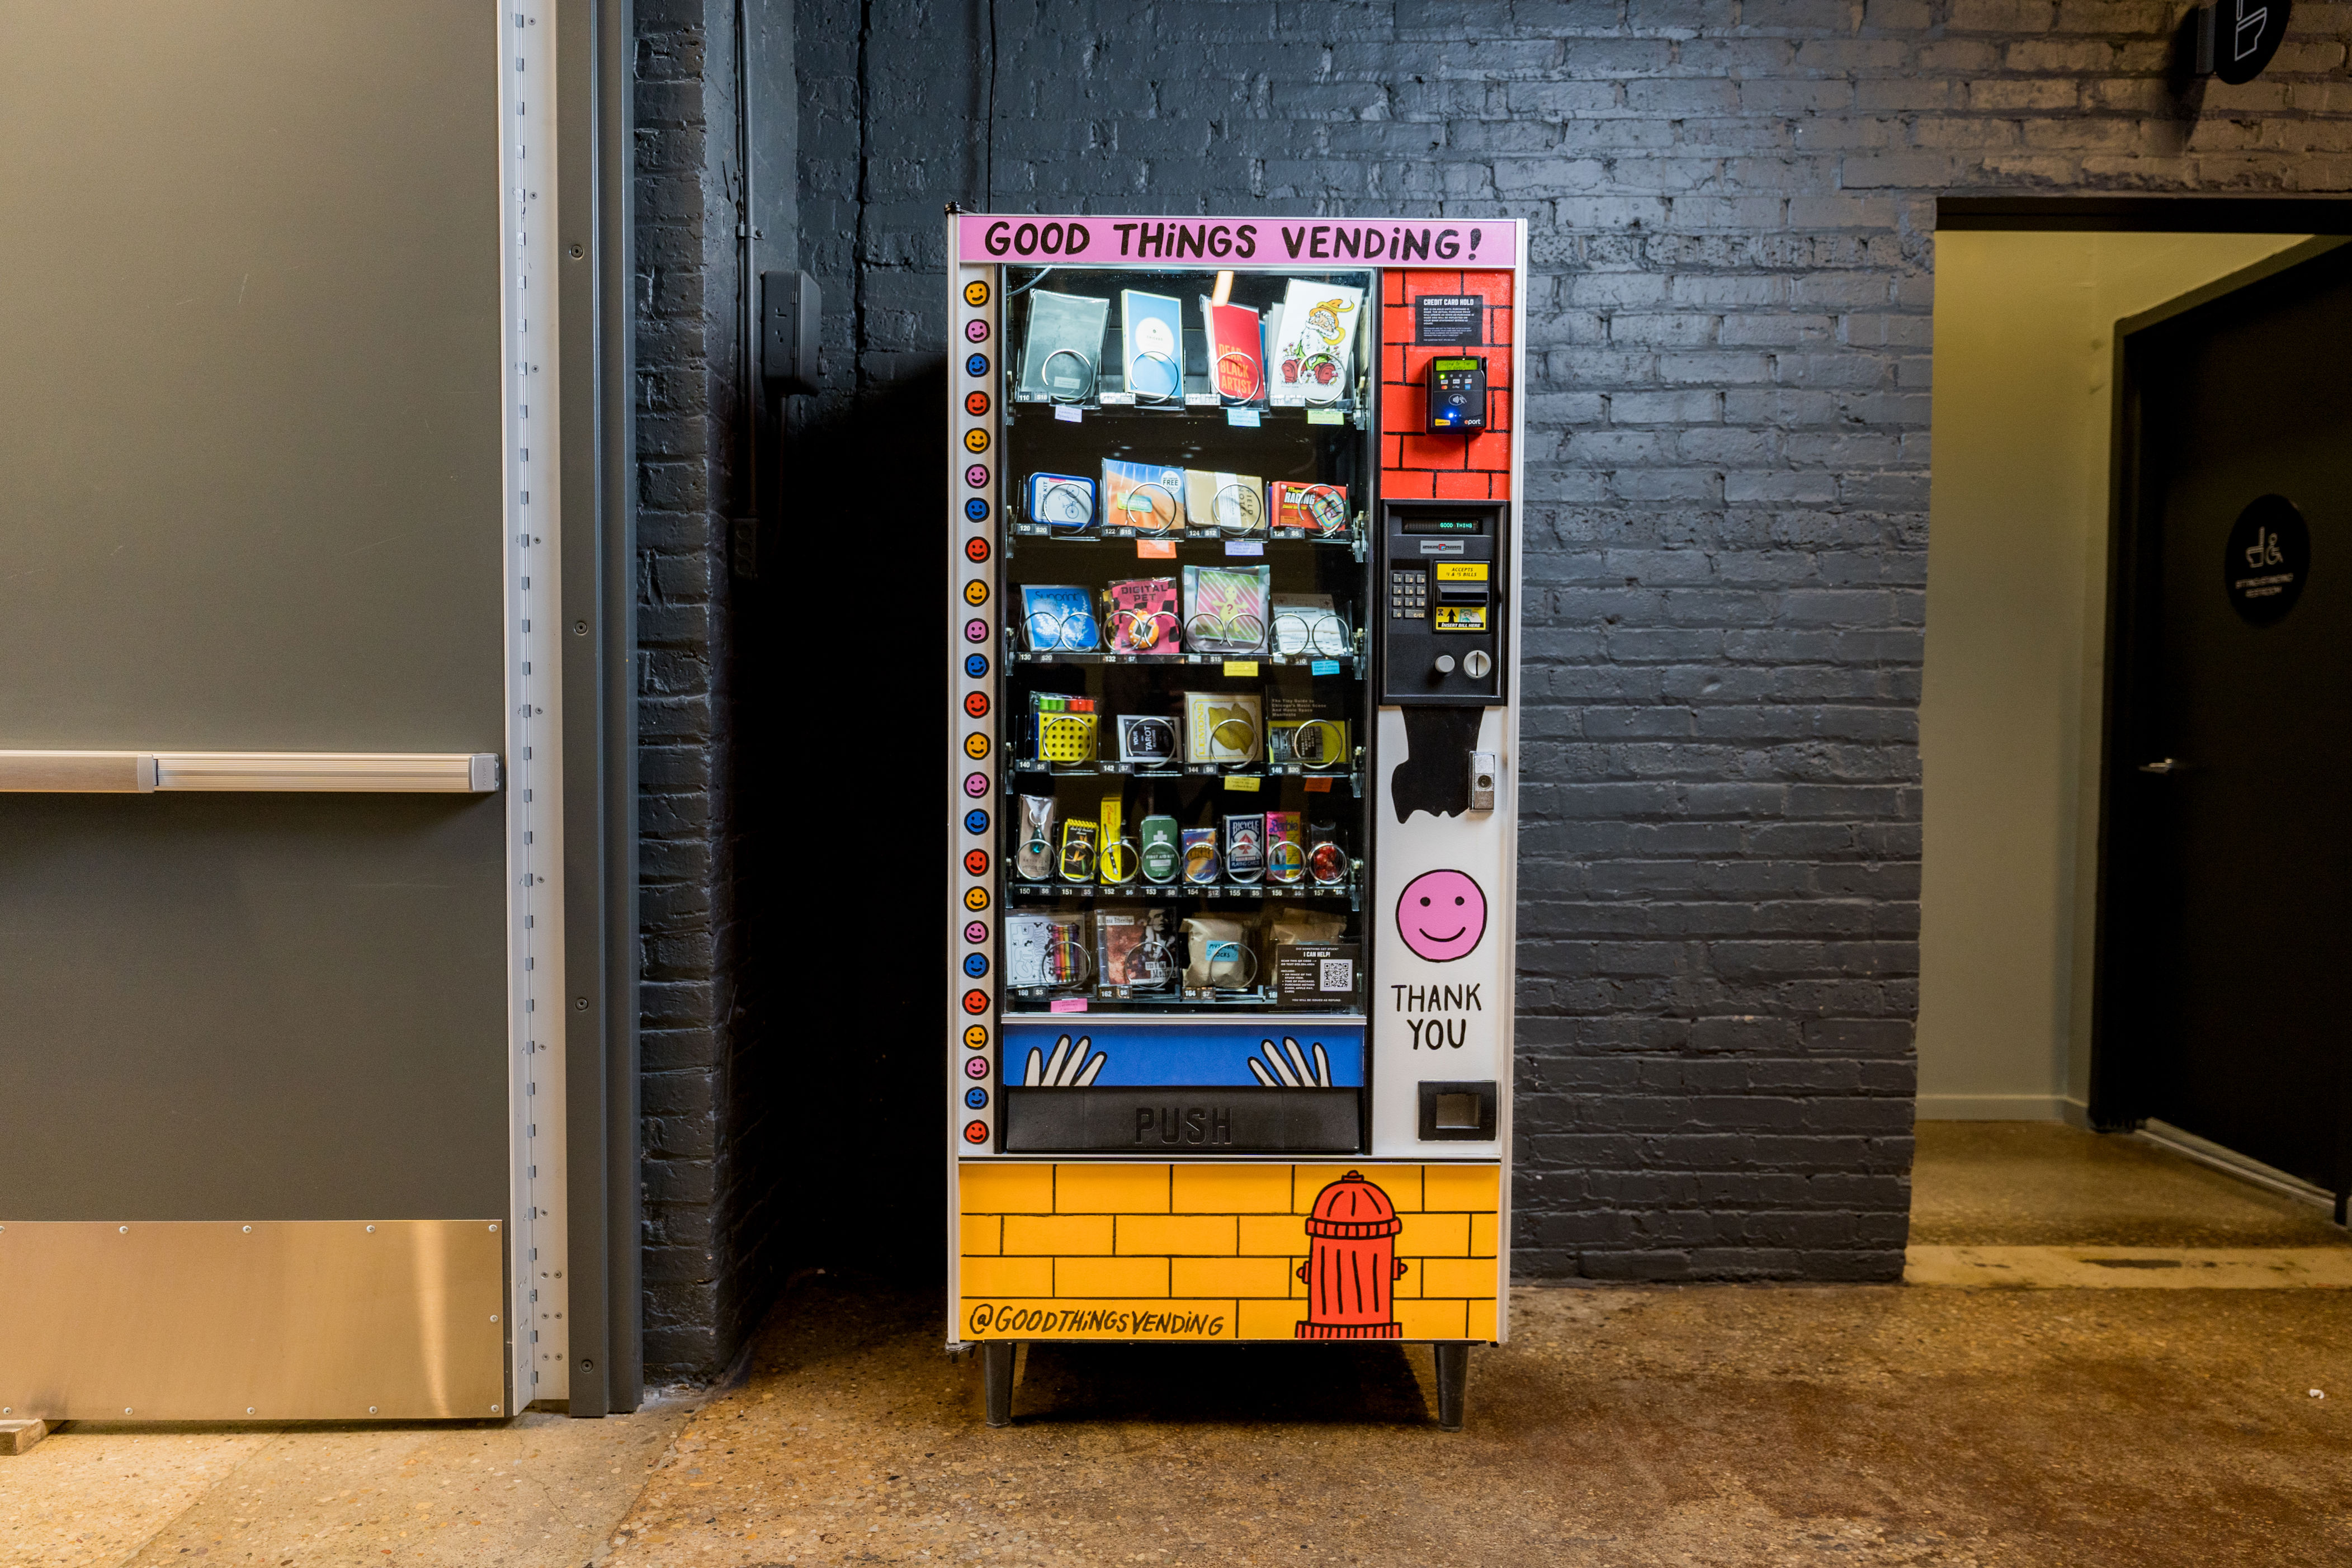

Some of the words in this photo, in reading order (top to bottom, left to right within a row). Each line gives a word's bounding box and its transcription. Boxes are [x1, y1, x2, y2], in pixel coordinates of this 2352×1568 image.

[985, 221, 1090, 256] GOOD
[1218, 343, 1243, 362] DEAR
[1220, 360, 1249, 379] BLACK
[1221, 375, 1252, 394] ARTIST
[1033, 591, 1079, 605] Sunprint
[1121, 584, 1168, 594] DIGITAL
[1227, 603, 1234, 614] ?
[1144, 725, 1153, 752] TAROT
[1232, 821, 1259, 833] BICYCLE
[1269, 820, 1298, 832] Barbie
[1391, 983, 1481, 1012] THANK
[1406, 1019, 1466, 1050] YOU
[1135, 1107, 1232, 1144] PUSH
